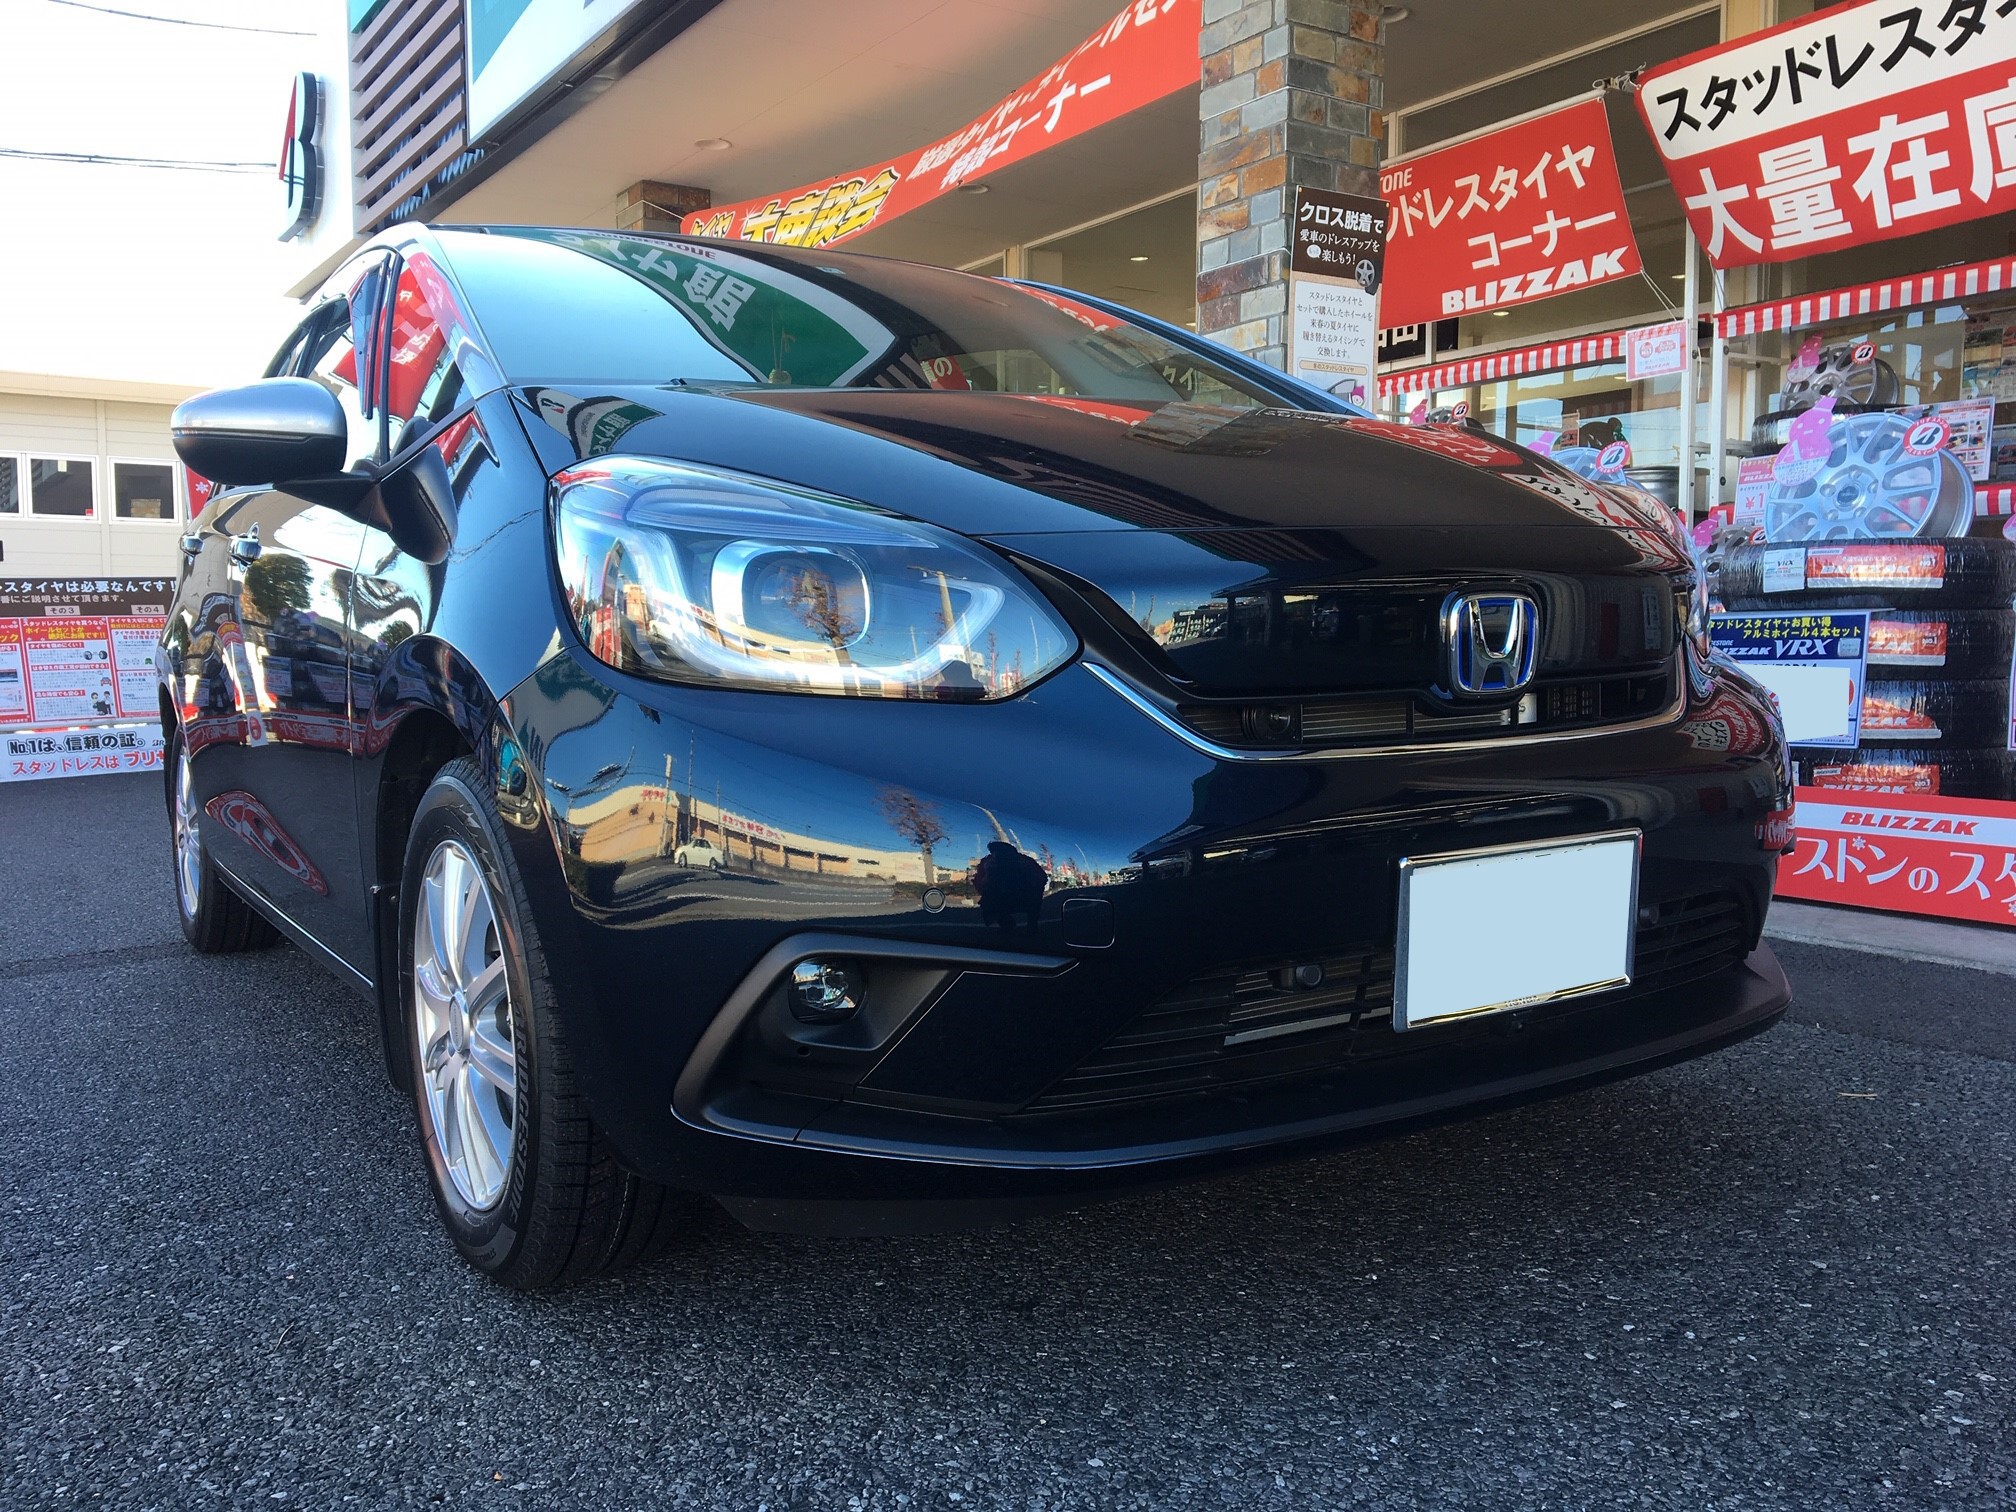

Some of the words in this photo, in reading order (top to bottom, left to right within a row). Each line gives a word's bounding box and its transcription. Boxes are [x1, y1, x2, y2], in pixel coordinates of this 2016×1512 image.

[1380, 167, 1413, 194] ONE
[1300, 201, 1385, 234] クロス脱着で
[1299, 228, 1381, 253] 愛車のドレスアップを
[1467, 209, 1617, 270] コーナー
[1442, 245, 1629, 315] BLIZZAK
[1309, 291, 1363, 306] スタッドレスタイヤと
[1297, 304, 1373, 321] セットで購入したホイールを
[0, 580, 177, 594] スタイヤは必要なんです!!
[1774, 638, 1834, 659] VRX
[12, 755, 120, 776] スタッドレスは
[1841, 811, 1980, 836] BLIZZAK
